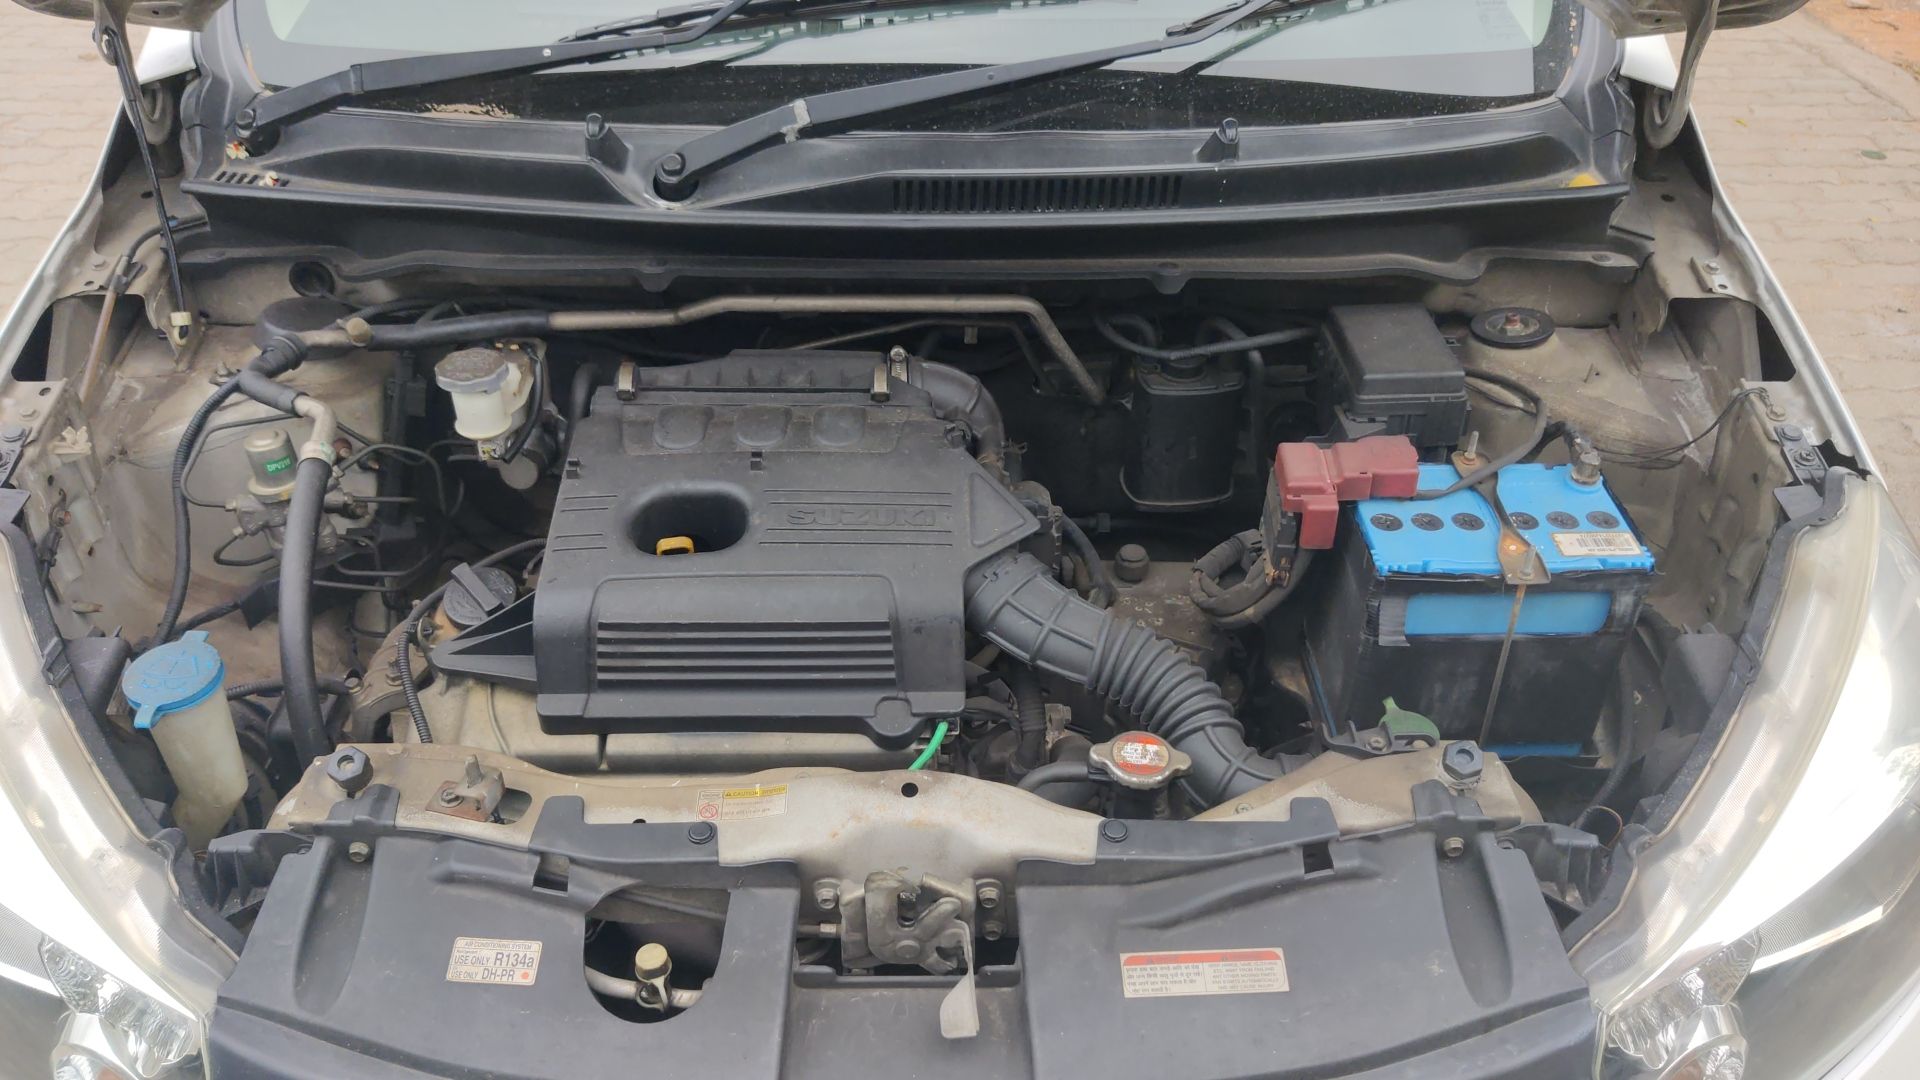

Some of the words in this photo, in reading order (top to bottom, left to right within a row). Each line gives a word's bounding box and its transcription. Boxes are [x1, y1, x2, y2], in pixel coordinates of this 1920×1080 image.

[786, 508, 937, 527] SUZUKI
[454, 954, 470, 965] USE
[470, 955, 491, 966] ONLY
[494, 952, 535, 968] R134a
[450, 970, 463, 978] USE
[463, 970, 478, 979] ONLY
[482, 968, 516, 981] DH-PR
